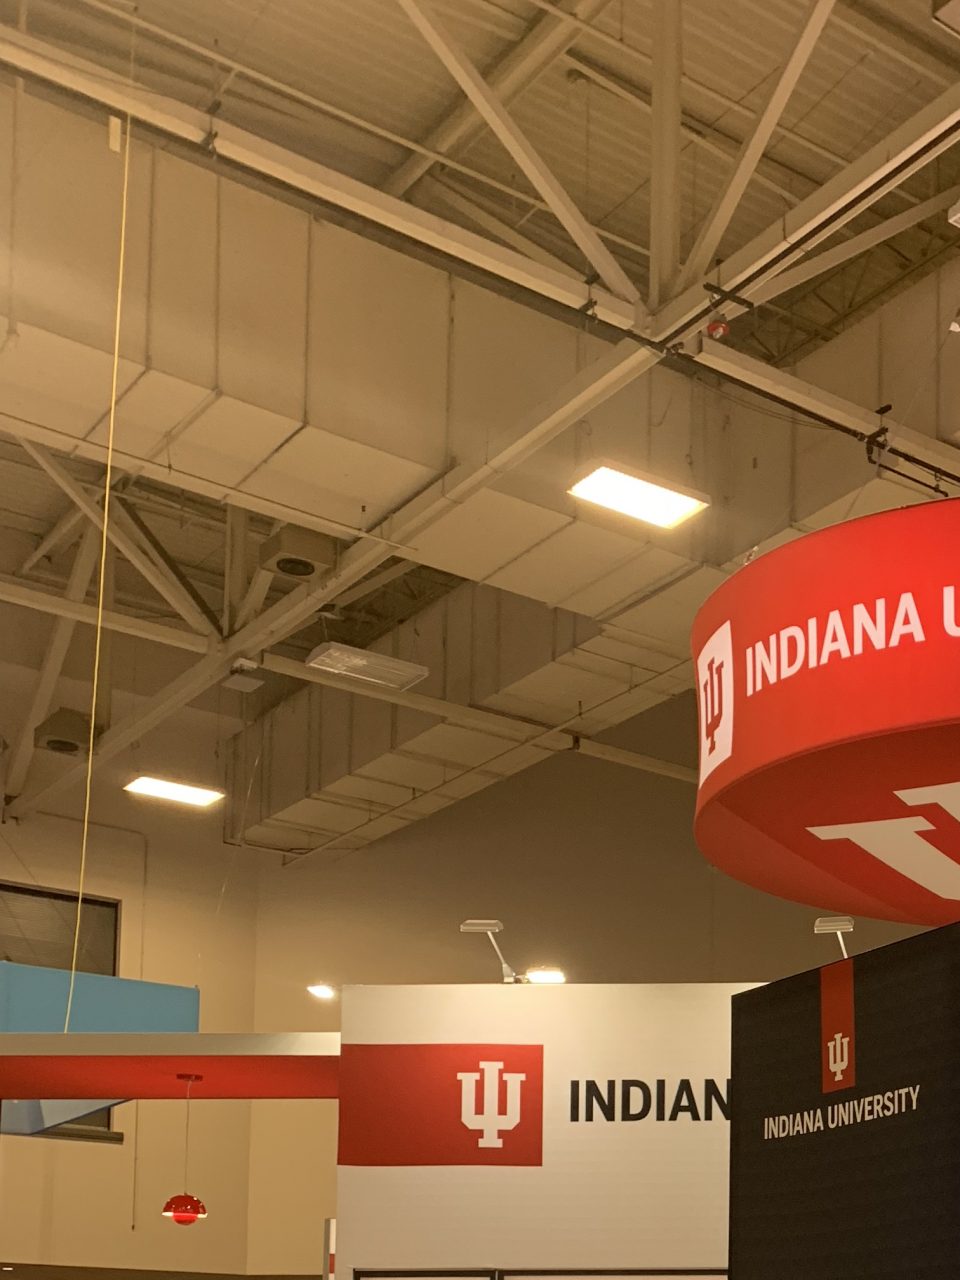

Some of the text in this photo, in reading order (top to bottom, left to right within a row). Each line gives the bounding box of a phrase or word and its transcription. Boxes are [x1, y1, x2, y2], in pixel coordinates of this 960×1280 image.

[745, 592, 925, 698] INDIANA
[764, 1084, 920, 1140] INDIANA UNIVERSITY
